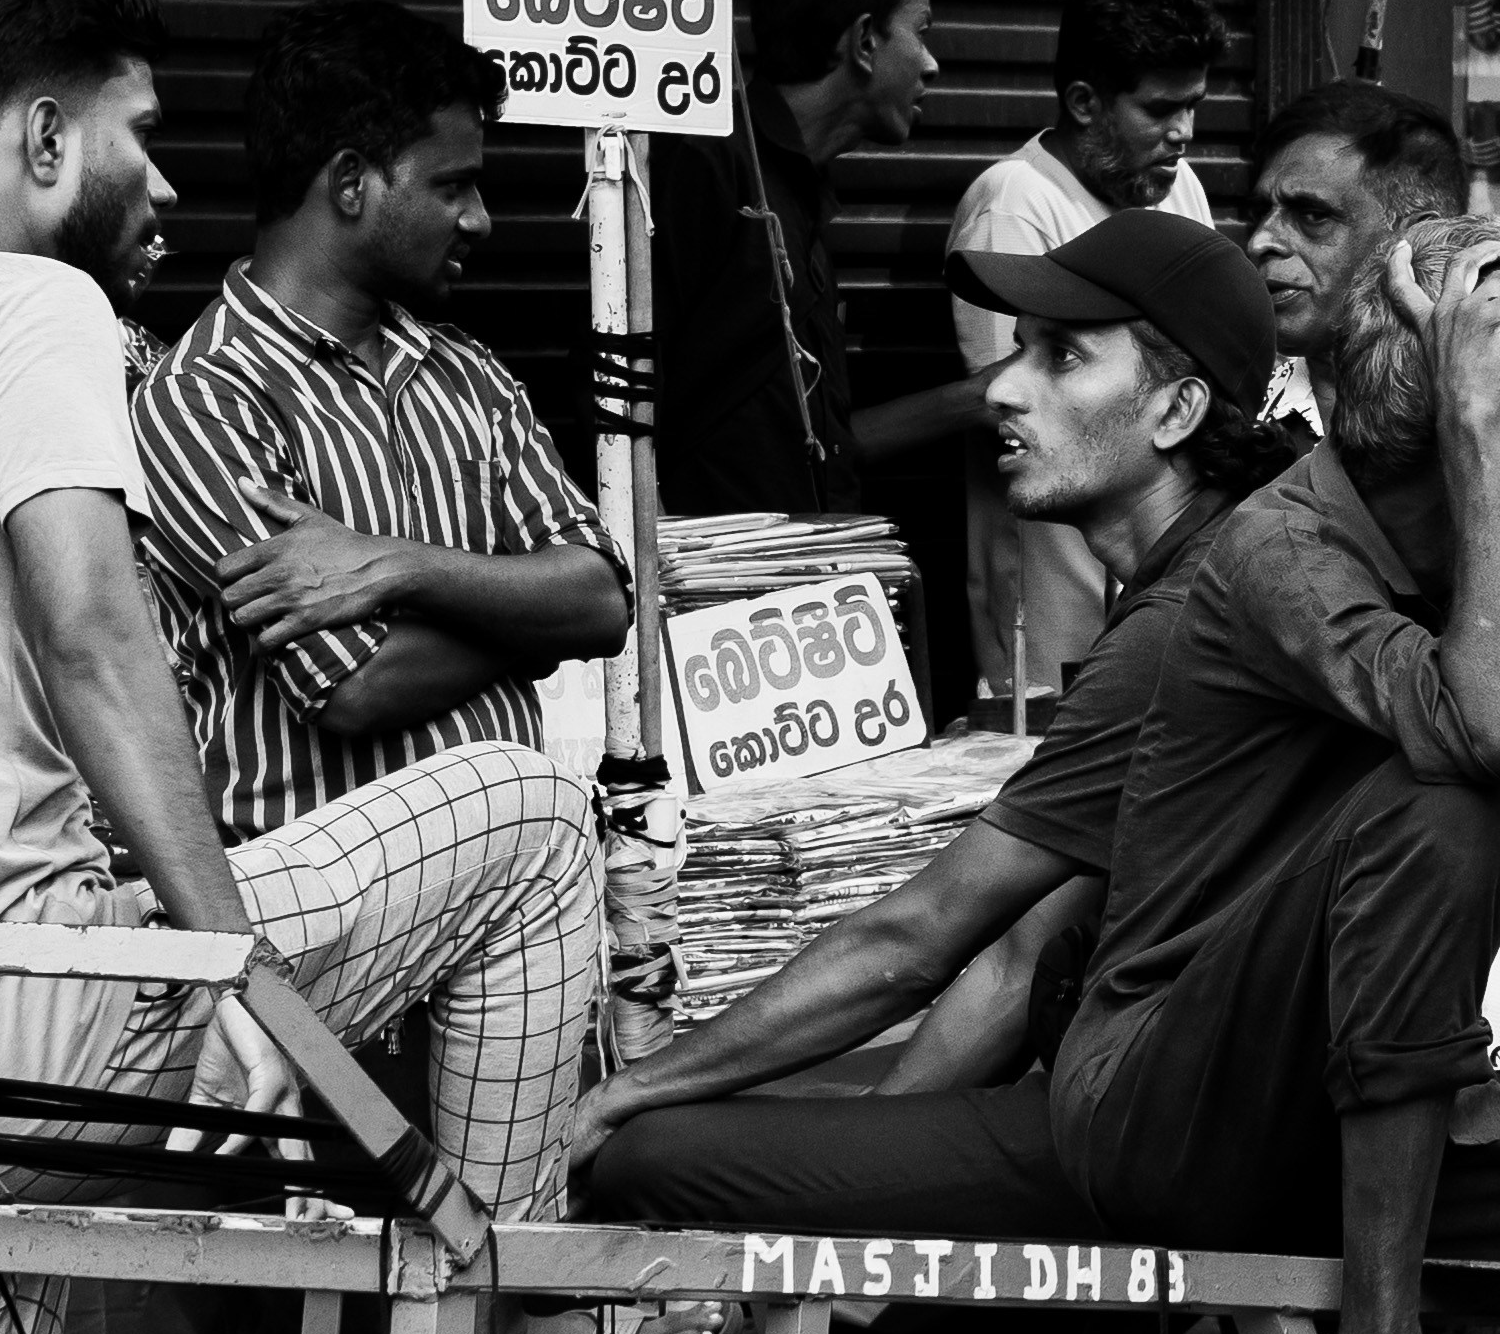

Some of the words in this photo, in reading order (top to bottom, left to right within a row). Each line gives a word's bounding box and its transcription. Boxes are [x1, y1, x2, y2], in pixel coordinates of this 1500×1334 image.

[657, 51, 722, 117] උර
[708, 701, 840, 779] කොට්ට
[853, 679, 910, 747] උර
[742, 1235, 1101, 1301] MASJIDH
